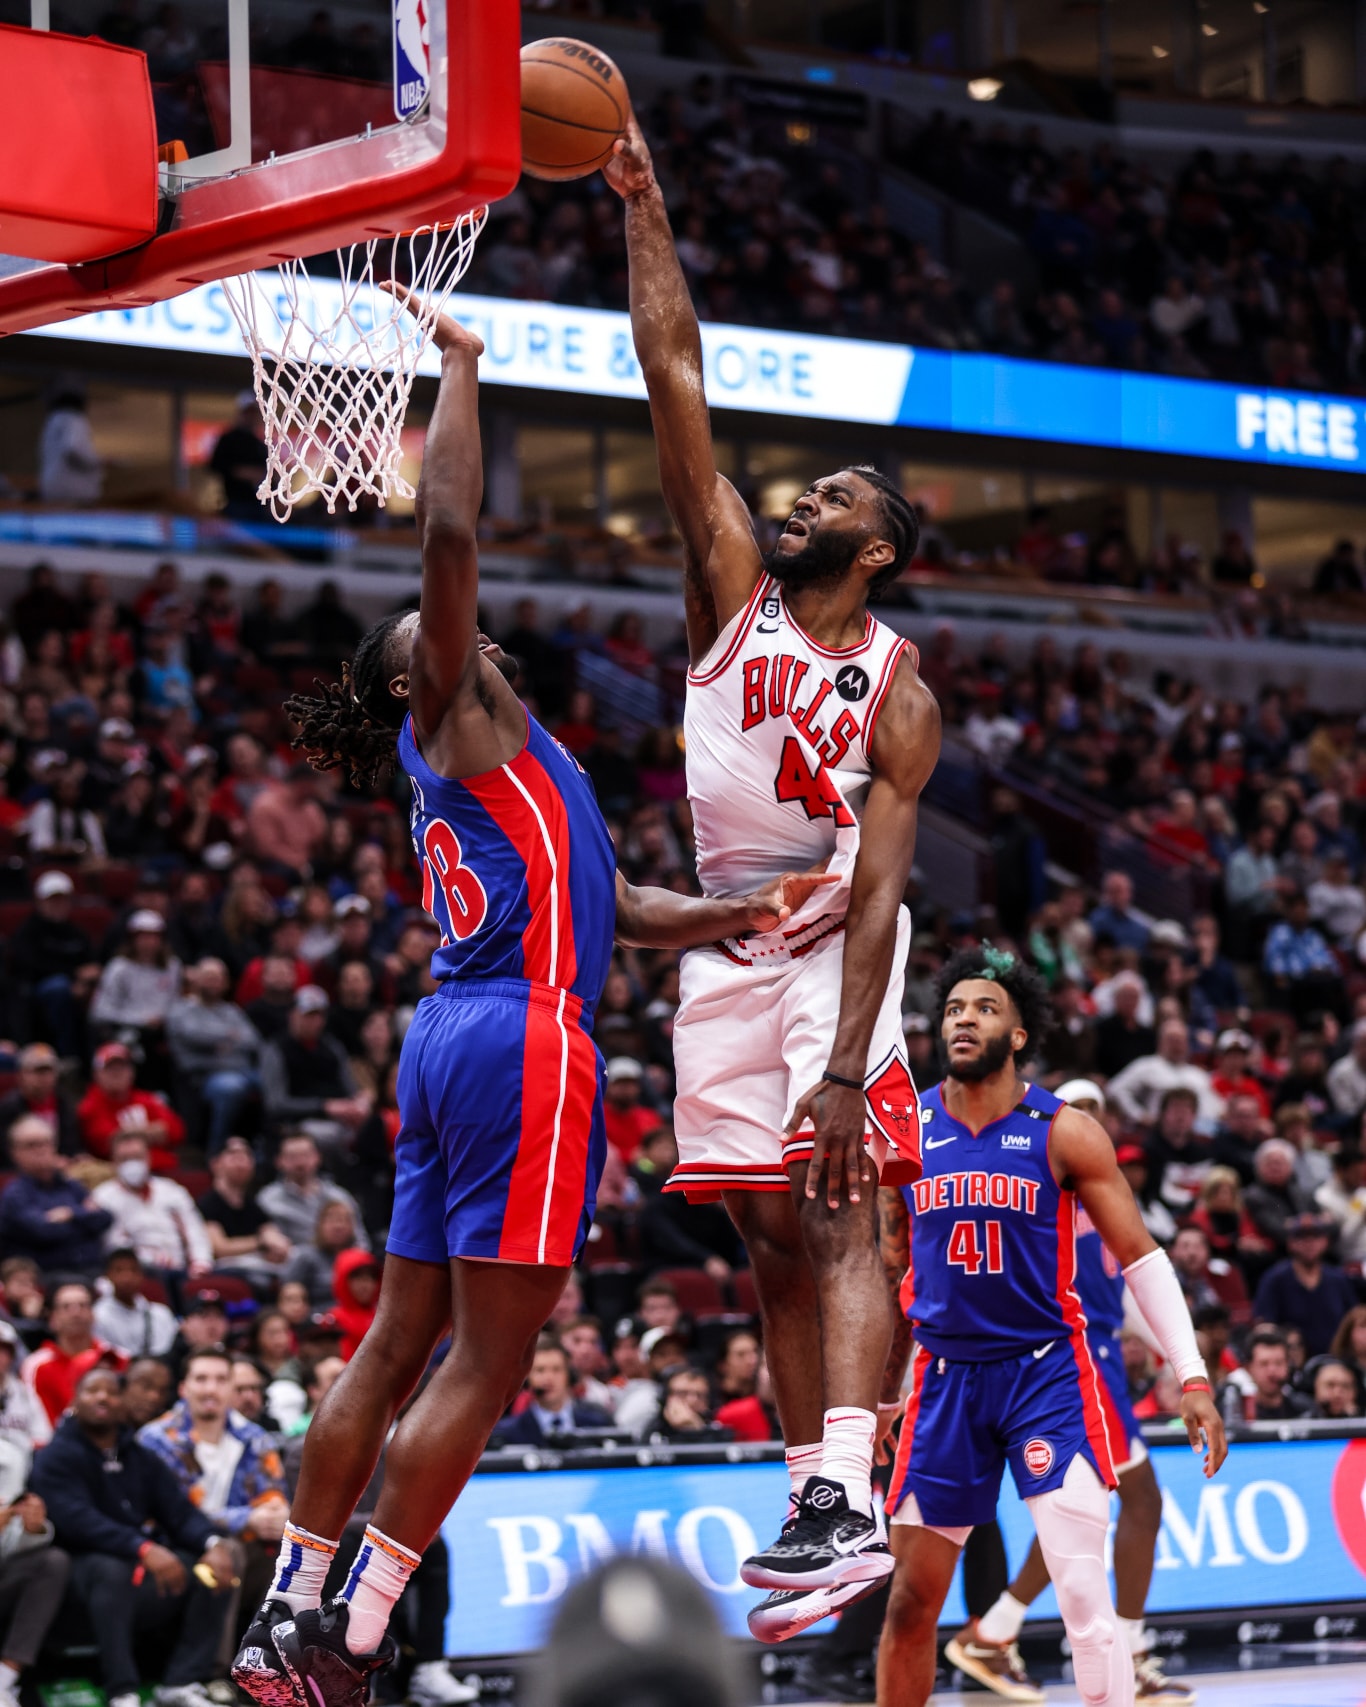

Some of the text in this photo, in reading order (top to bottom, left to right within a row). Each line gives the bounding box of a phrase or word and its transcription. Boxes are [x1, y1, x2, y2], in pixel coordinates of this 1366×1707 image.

[400, 79, 426, 111] NBA
[711, 343, 815, 397] ORE
[1236, 393, 1359, 461] FREE
[763, 600, 779, 617] 6
[741, 653, 861, 769] BULLS
[921, 1108, 934, 1124] 6
[1001, 1134, 1031, 1147] UWM
[911, 1171, 1041, 1216] DETROIT
[947, 1220, 1003, 1275] 41
[1104, 1479, 1309, 1572] MO
